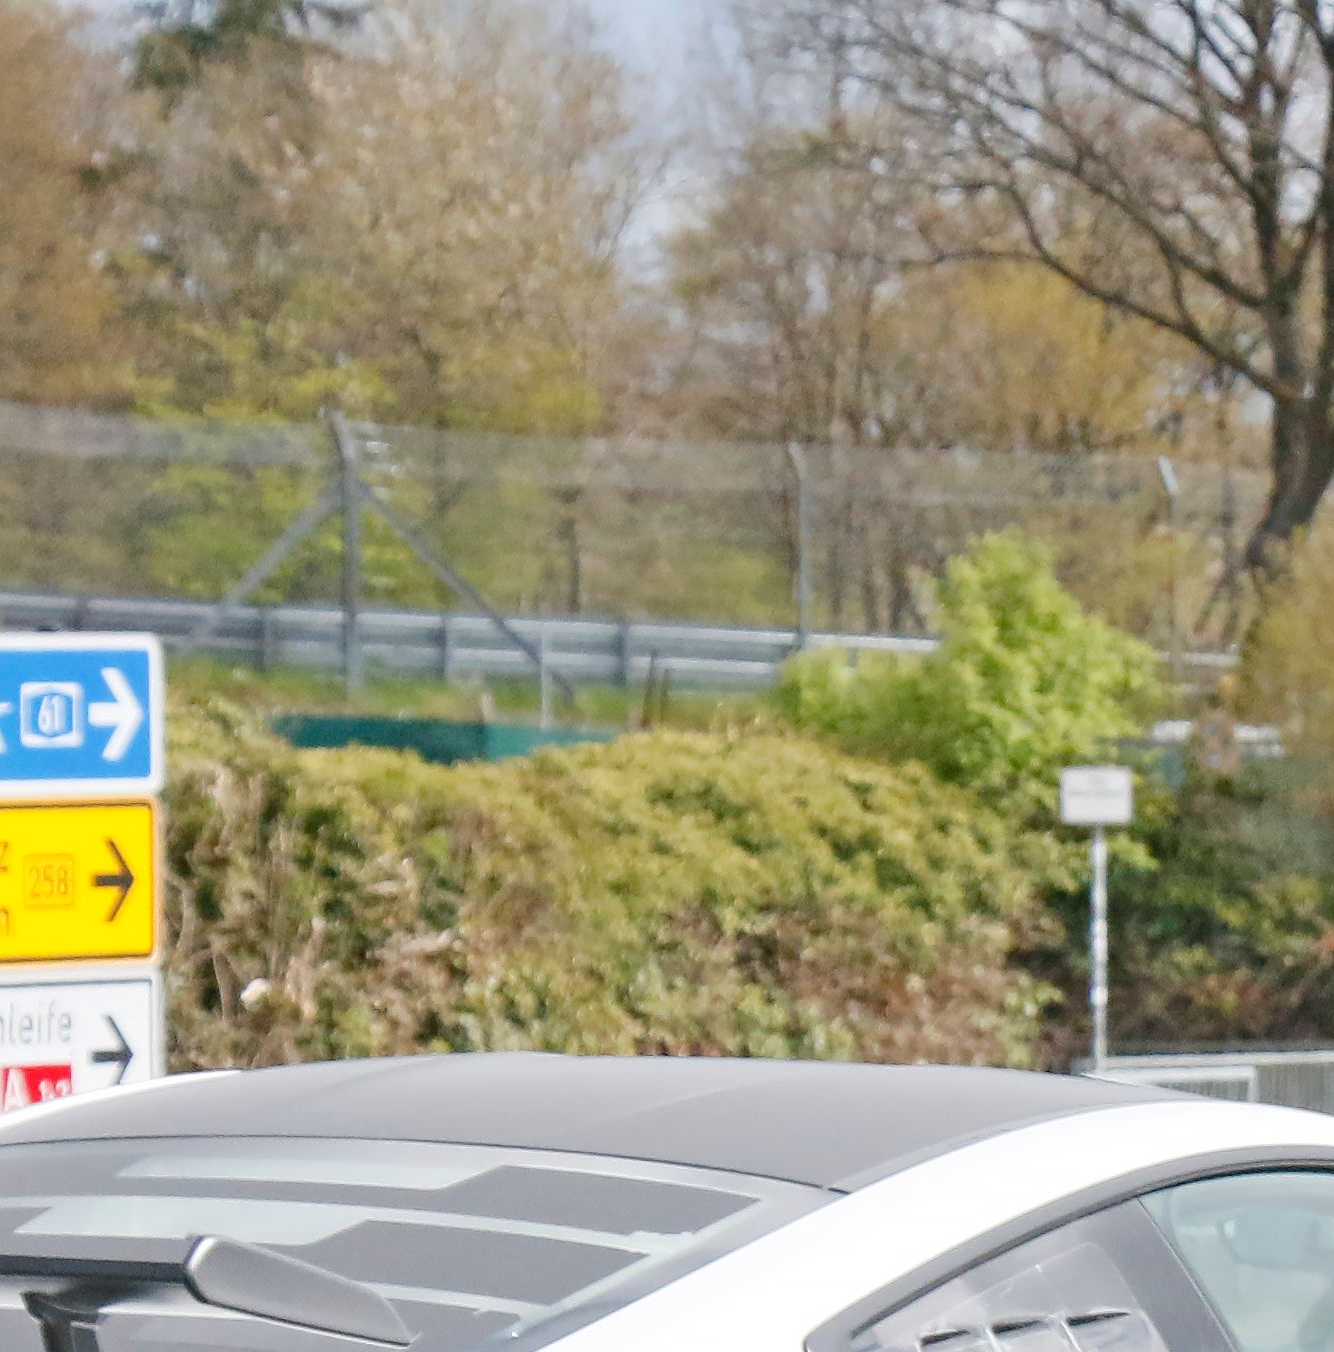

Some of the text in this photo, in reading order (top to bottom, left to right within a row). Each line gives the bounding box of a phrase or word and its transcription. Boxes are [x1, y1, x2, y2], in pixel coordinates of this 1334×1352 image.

[38, 695, 66, 735] 61
[29, 865, 67, 896] 258
[3, 1069, 30, 1112] A
